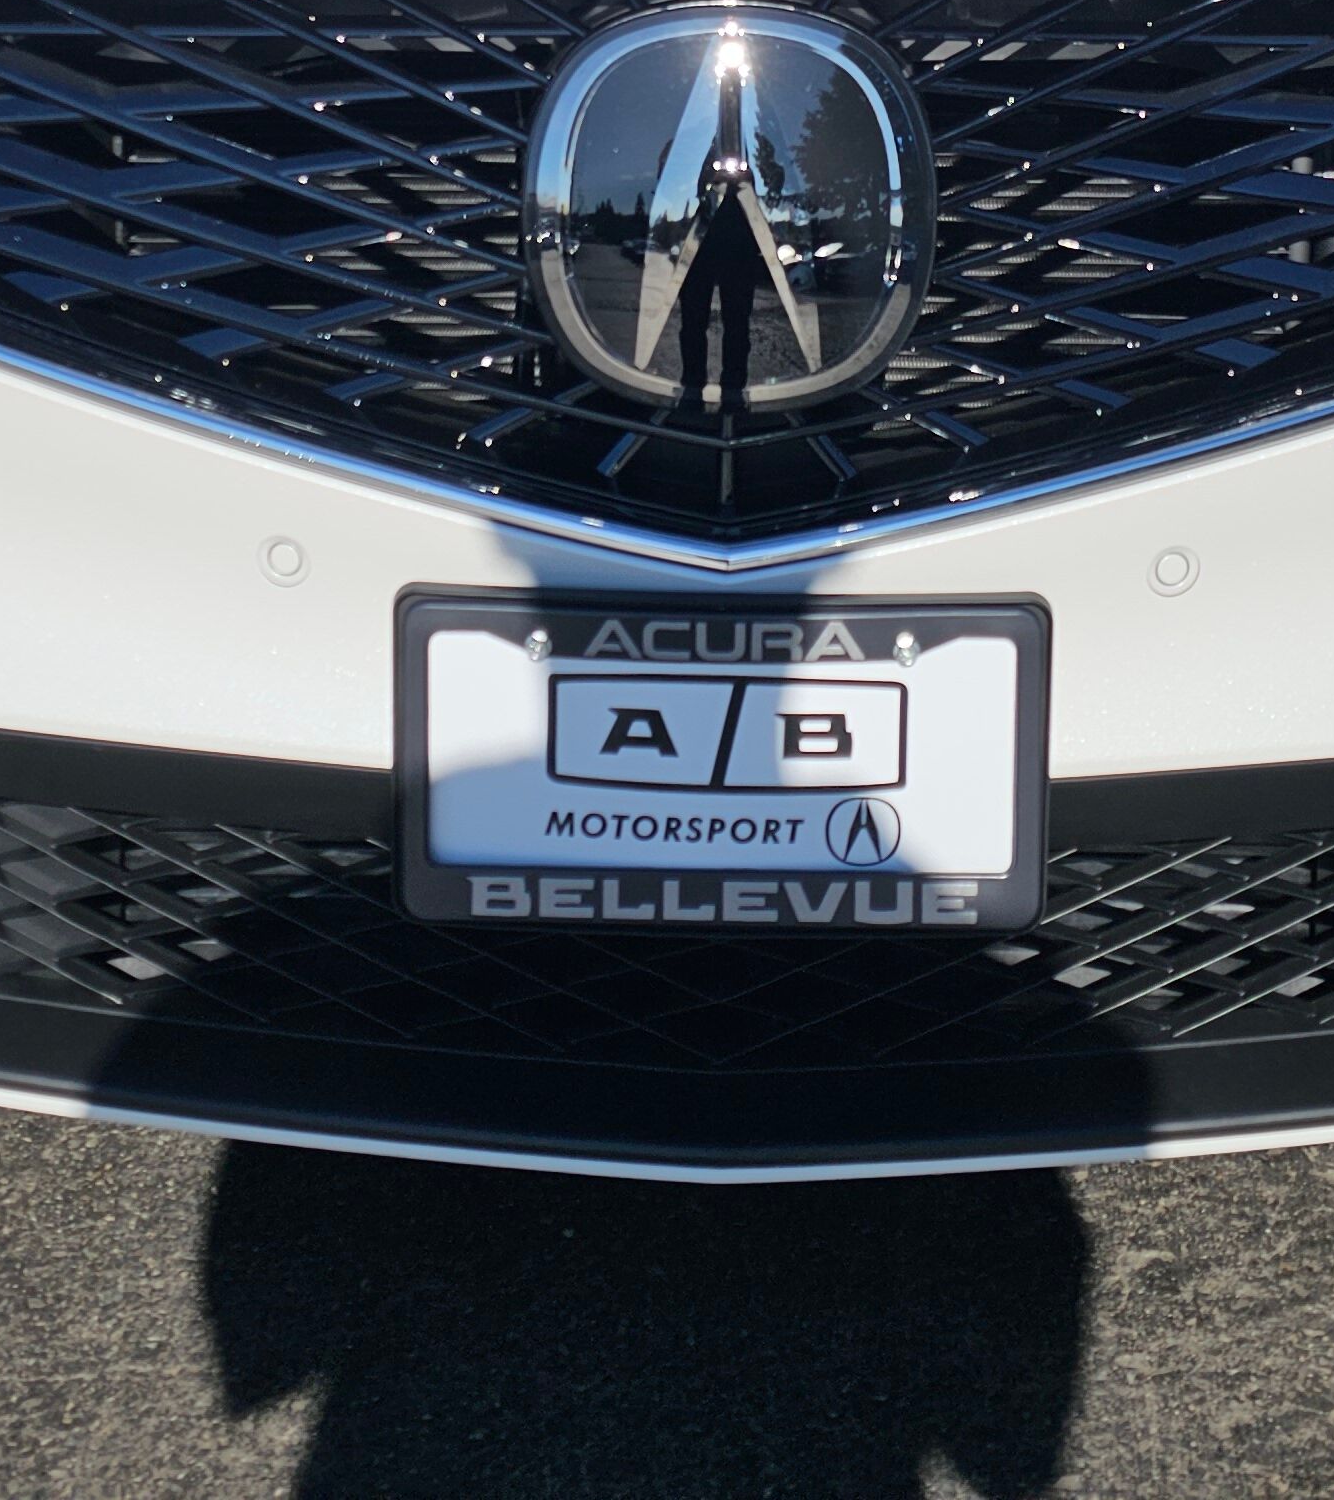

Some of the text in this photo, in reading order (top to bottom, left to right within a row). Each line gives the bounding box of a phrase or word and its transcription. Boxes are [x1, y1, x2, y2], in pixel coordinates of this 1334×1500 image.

[584, 619, 865, 663] ACURA
[599, 707, 854, 760] A B
[545, 811, 805, 844] MOTORSPORT
[466, 875, 979, 926] BELLEVUE
